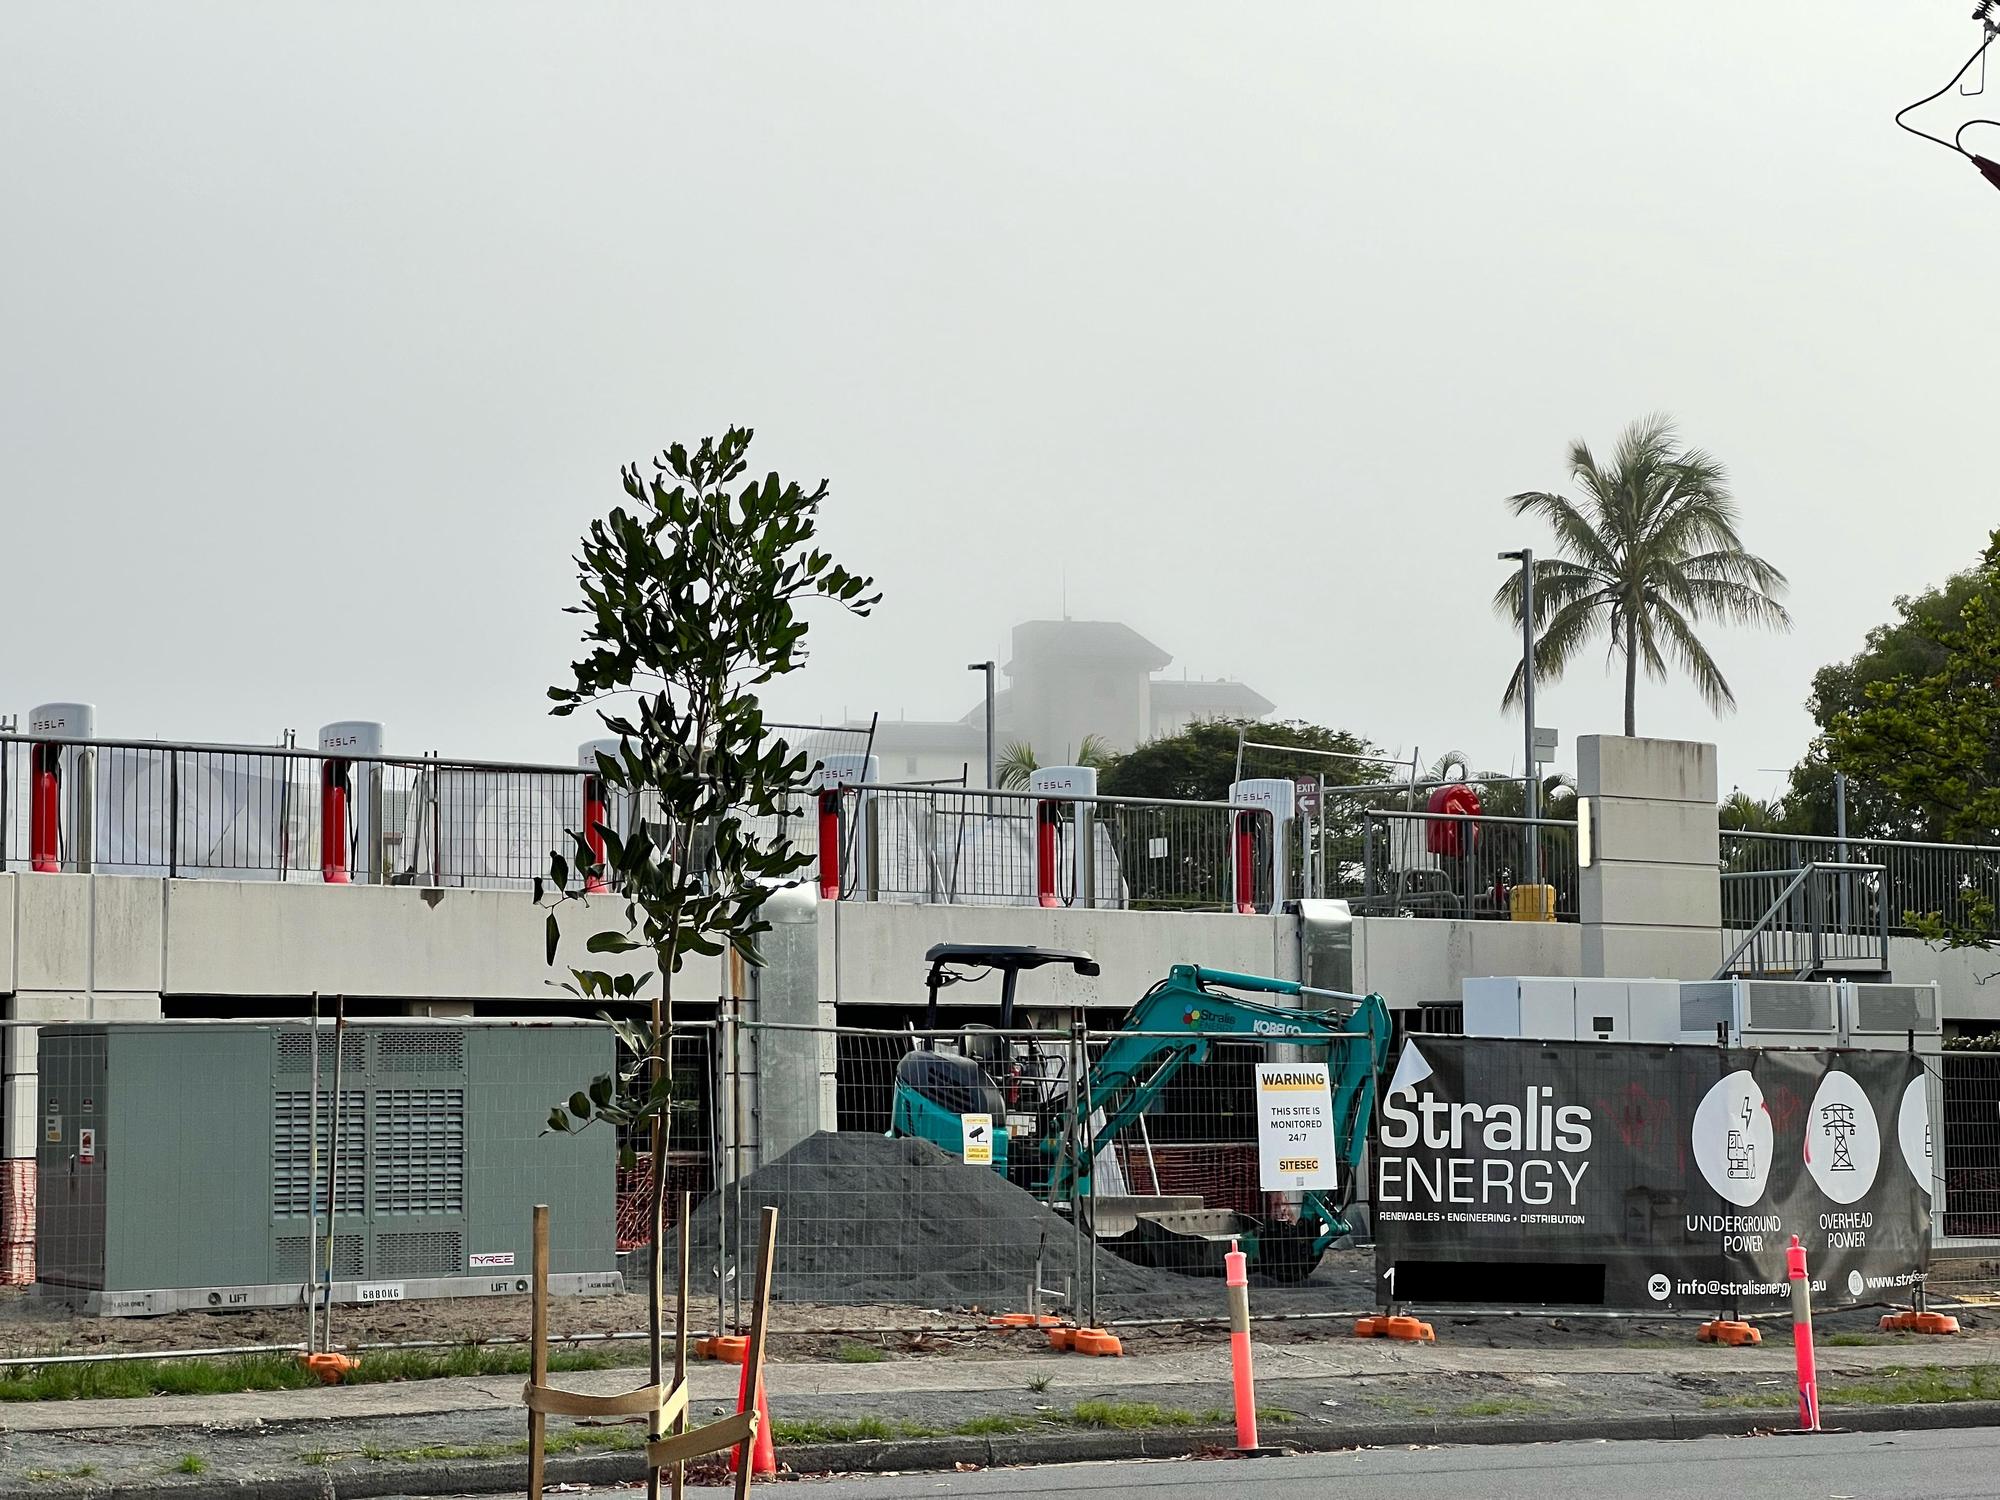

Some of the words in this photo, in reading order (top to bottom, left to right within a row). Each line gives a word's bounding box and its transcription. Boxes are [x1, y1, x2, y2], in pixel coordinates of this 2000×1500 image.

[33, 719, 65, 731] TESLA
[324, 736, 357, 748] TESLA
[819, 769, 853, 779] TESLA
[1037, 780, 1072, 790] TESLA
[1296, 783, 1316, 793] EXIT
[1237, 792, 1271, 801] TESLA
[1253, 1019, 1302, 1034] KOBELCO
[1262, 1073, 1325, 1086] WARNING
[1271, 1107, 1291, 1116] THIS
[1293, 1107, 1311, 1115] SITE
[1312, 1107, 1321, 1115] IS
[1270, 1120, 1323, 1129] MONITORED
[1380, 1085, 1592, 1153] Stralis
[1288, 1133, 1307, 1142] 24/7
[1279, 1160, 1319, 1170] SITESEC
[1379, 1156, 1590, 1206] ENERGY
[1379, 1211, 1440, 1222] RENEWABLES
[1447, 1212, 1511, 1223] ENGINEERING
[1520, 1214, 1585, 1224] DISTRIBUTION
[1819, 1212, 1873, 1230] OVERHEAD
[1686, 1215, 1781, 1232] UNDERGROUND
[1724, 1235, 1764, 1252] POWER
[1827, 1231, 1866, 1249] POWER
[471, 1254, 514, 1264] TYREE
[491, 1282, 509, 1292] LIFT
[1677, 1279, 1827, 1298] info@stralisenergy.au
[229, 1294, 248, 1304] LIFT
[362, 1289, 399, 1299] 6880KG
